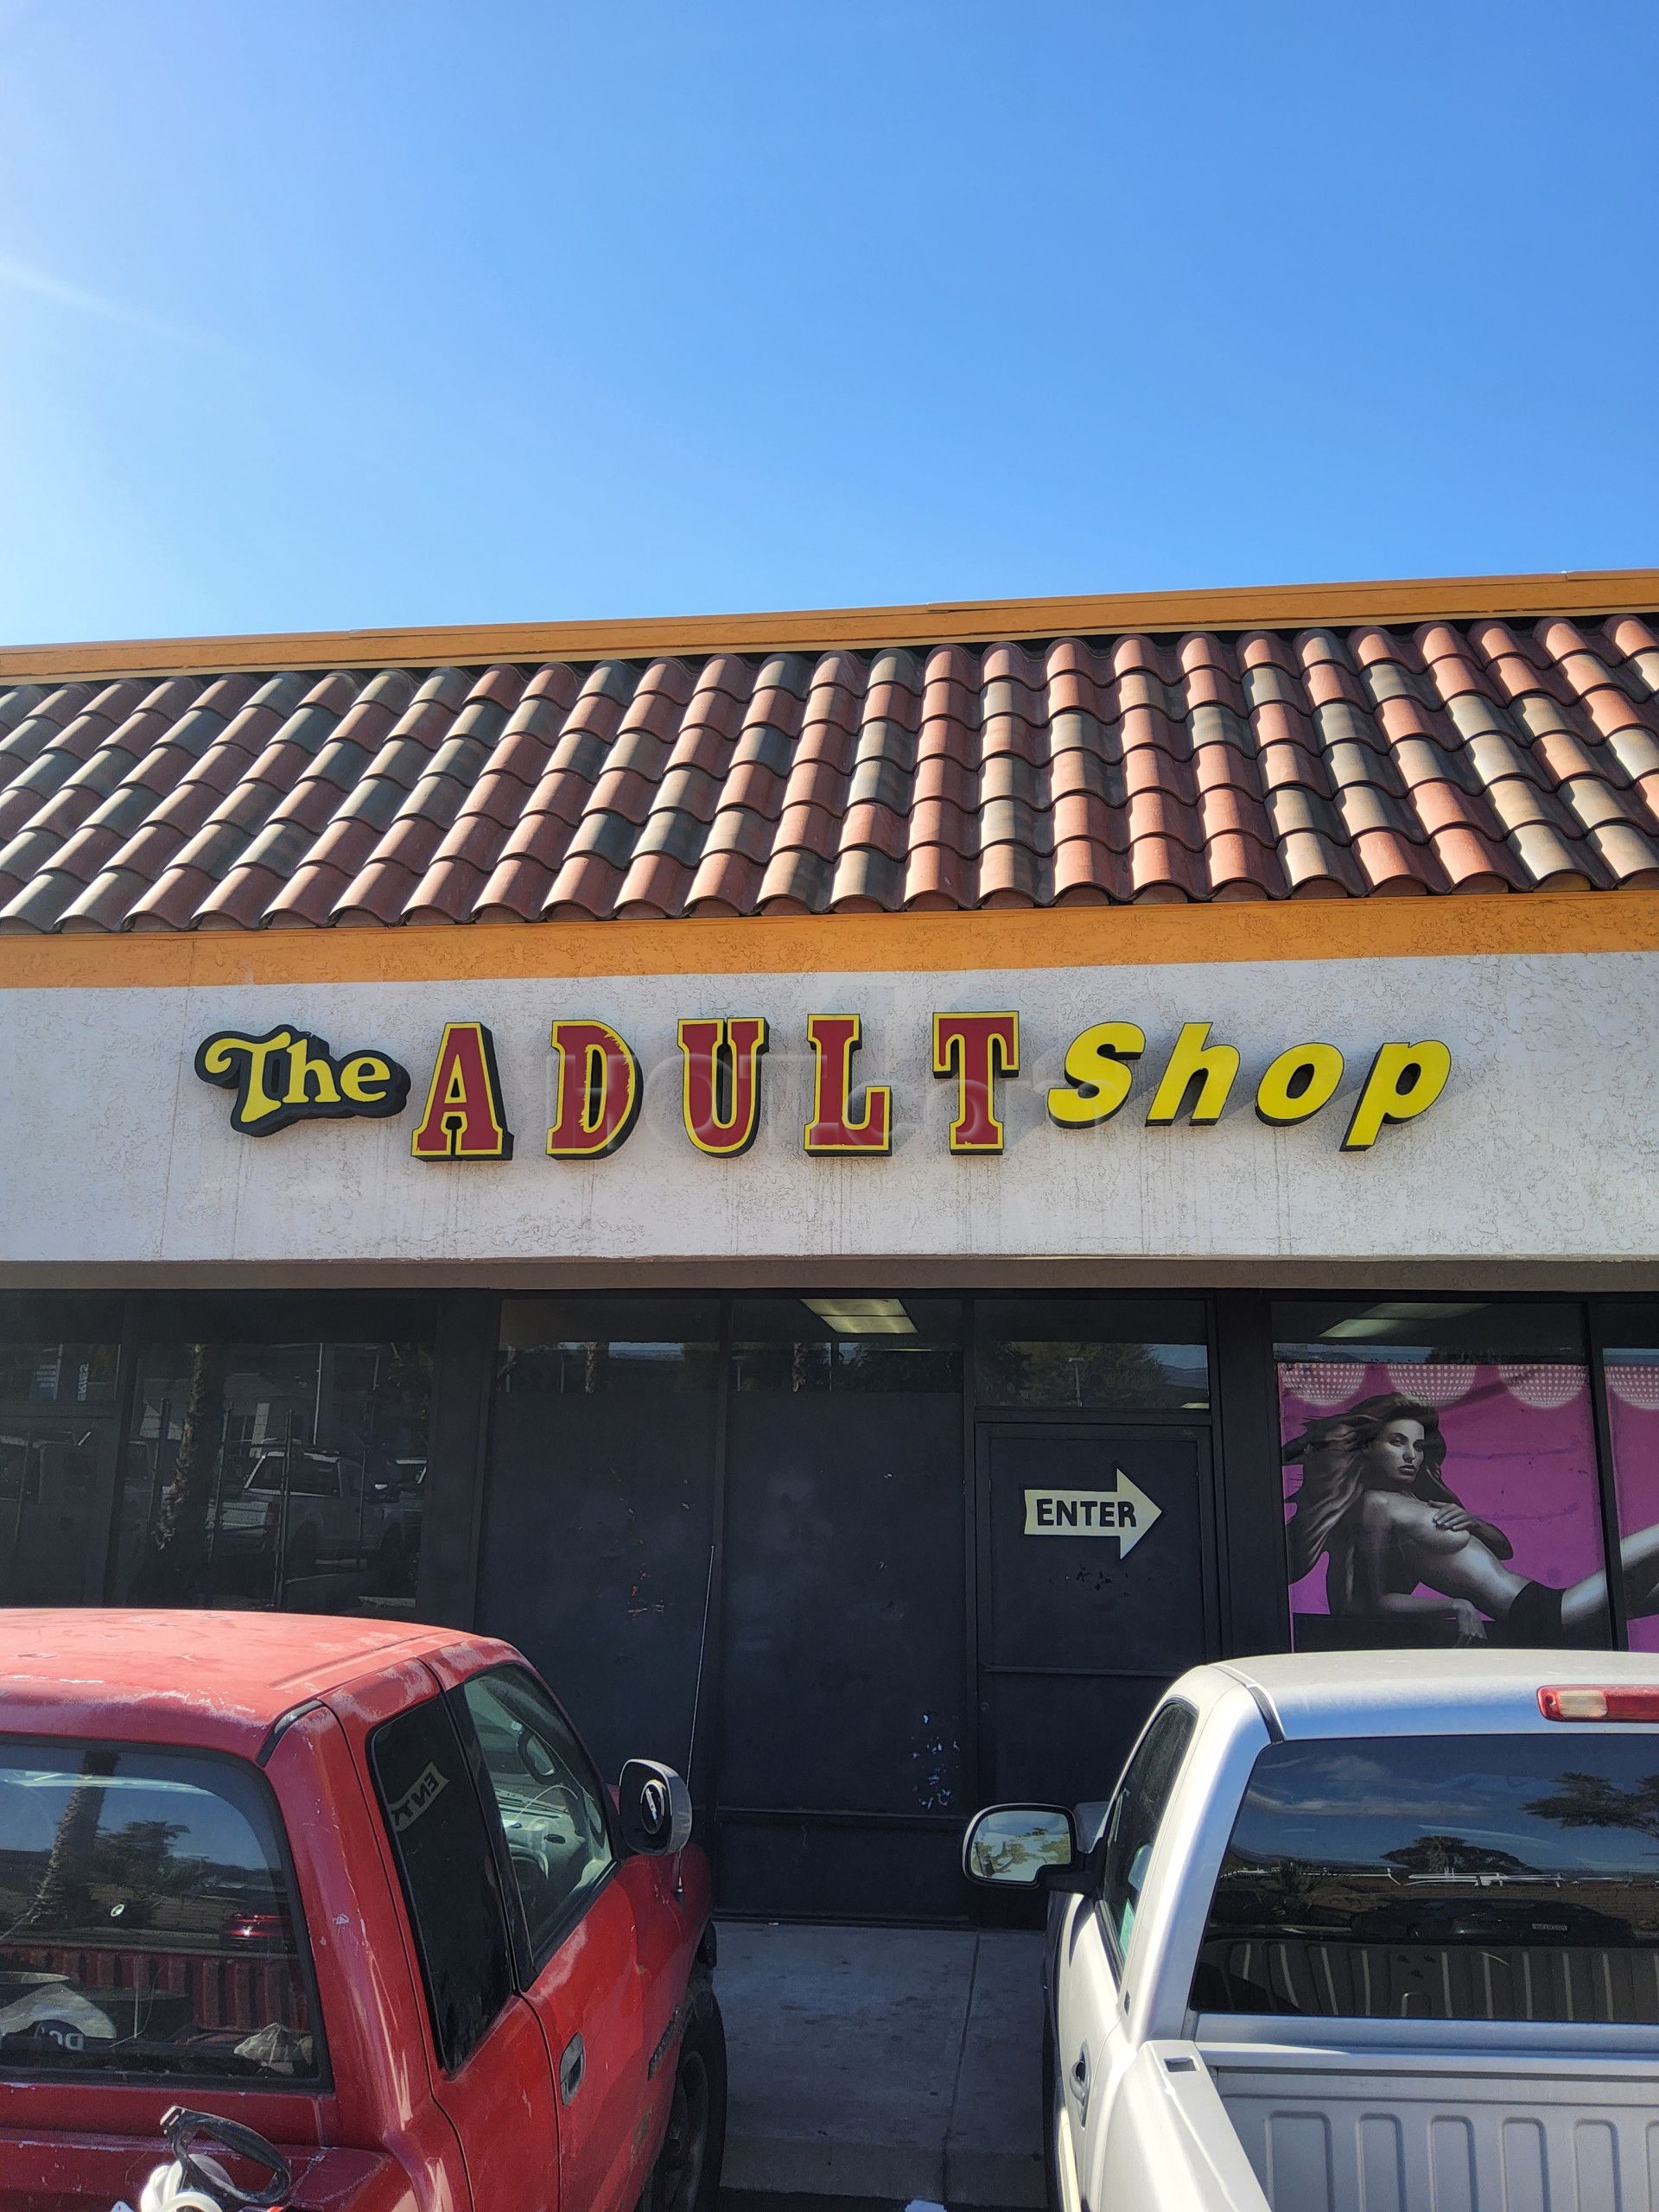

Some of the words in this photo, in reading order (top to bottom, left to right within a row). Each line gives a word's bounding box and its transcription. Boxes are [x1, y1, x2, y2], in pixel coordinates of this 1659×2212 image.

[200, 1028, 399, 1128] The
[410, 1011, 1020, 1160] ADULT
[1046, 1020, 1452, 1152] Shop
[1037, 1498, 1137, 1528] ENTER
